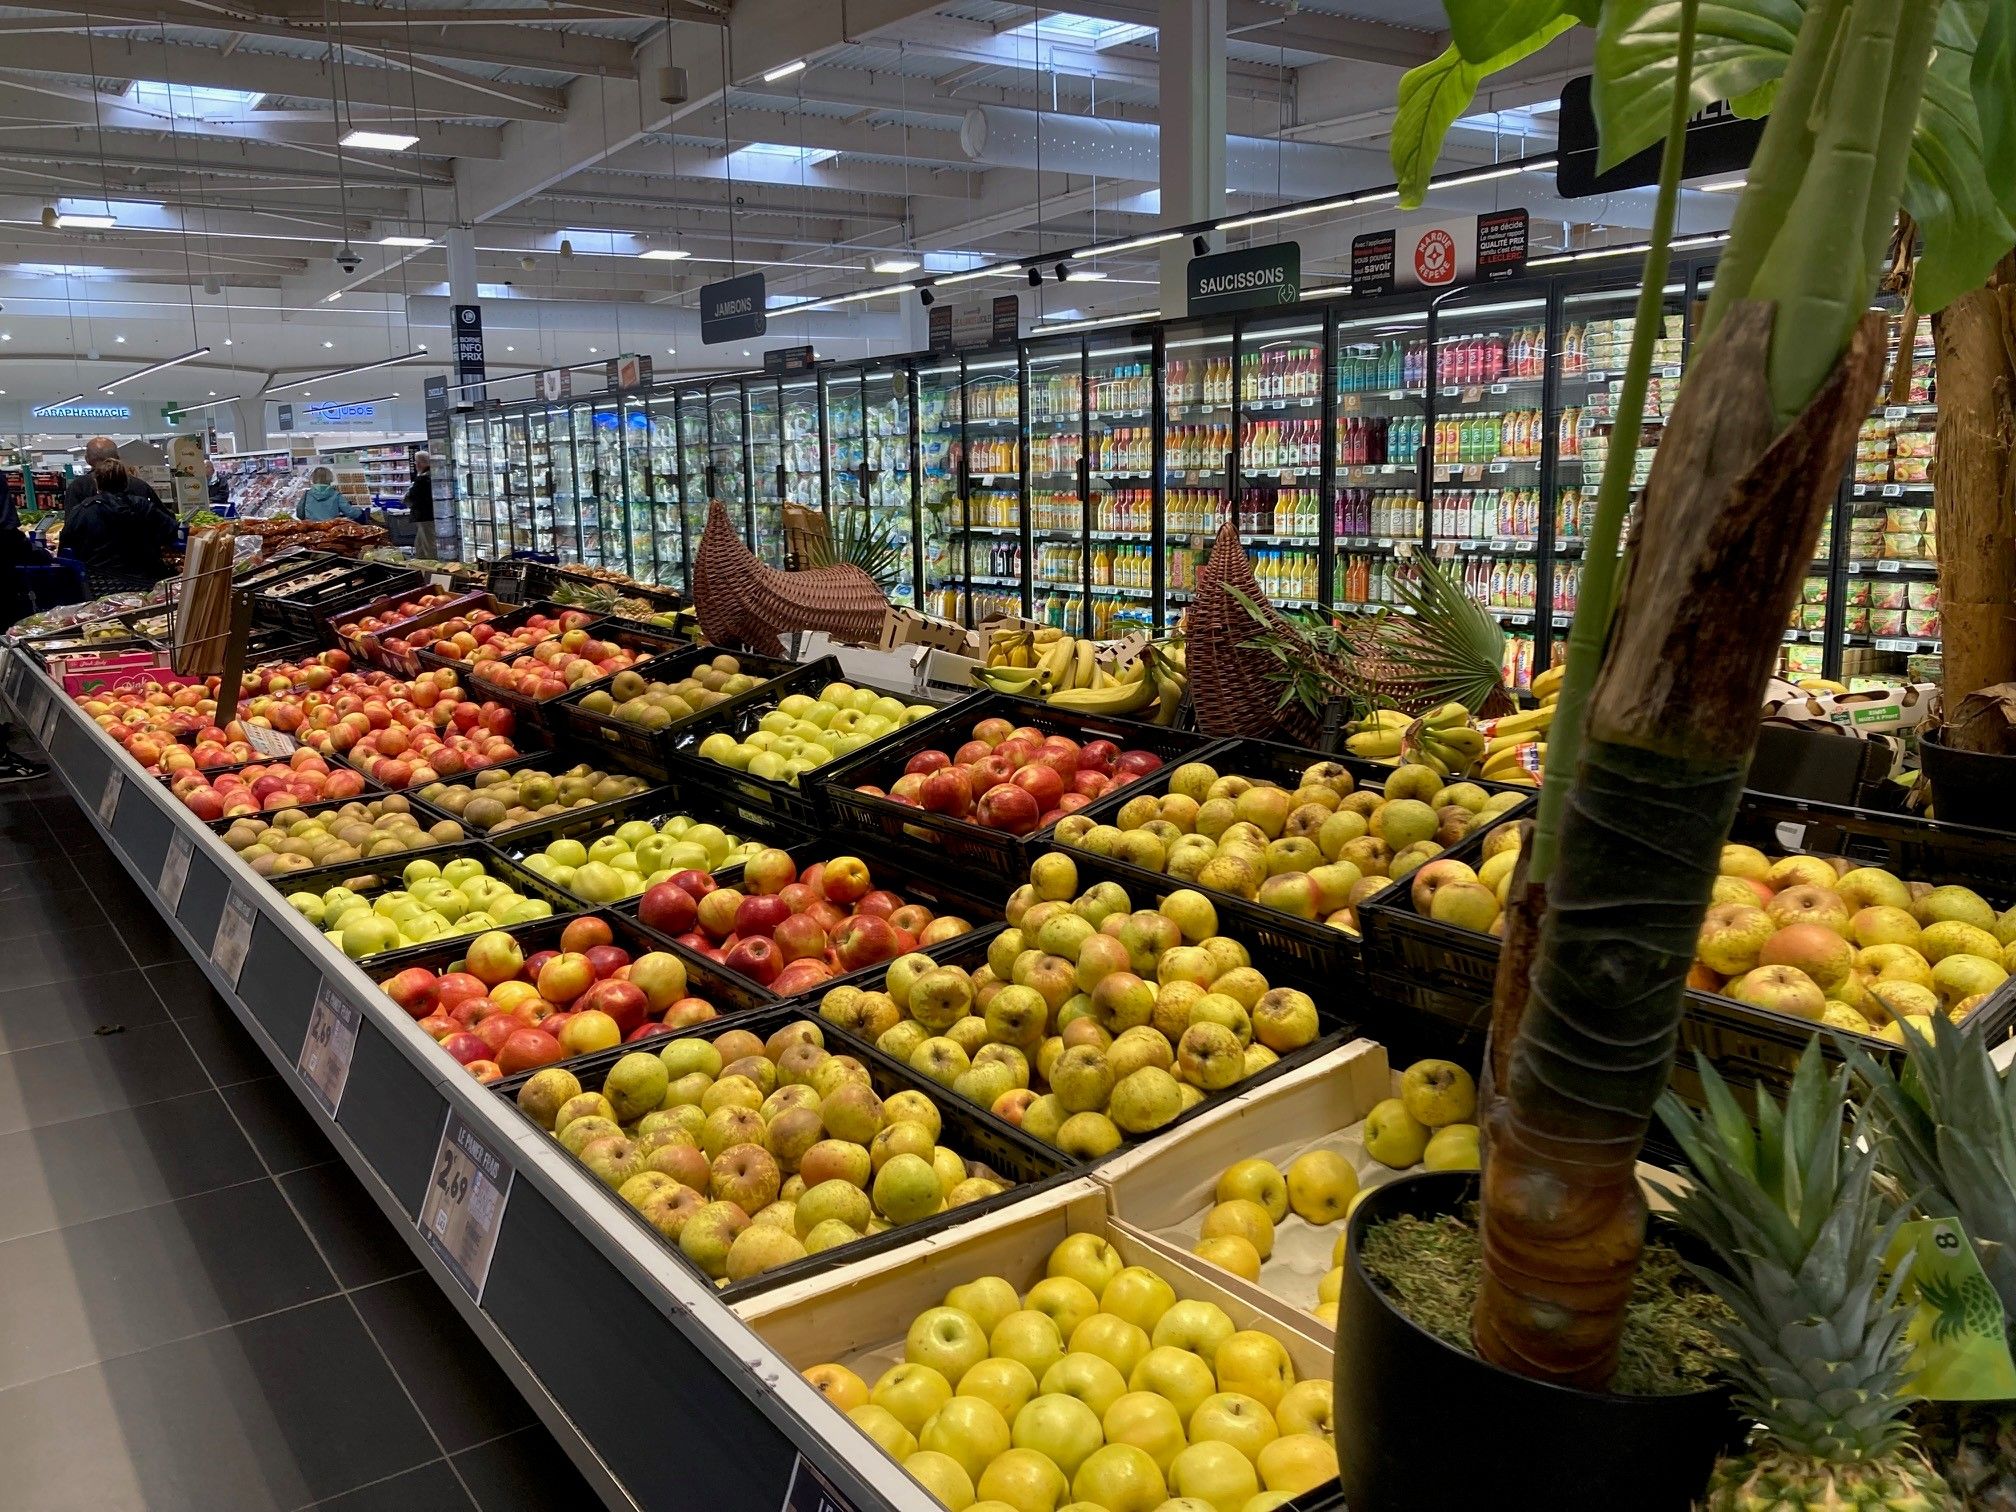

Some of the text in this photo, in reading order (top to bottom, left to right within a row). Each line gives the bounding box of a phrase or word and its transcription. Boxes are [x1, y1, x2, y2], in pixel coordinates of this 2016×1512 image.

[1418, 232, 1452, 252] MARQUE
[1509, 237, 1525, 245] PRIX
[1364, 261, 1391, 273] savoir
[1200, 267, 1284, 294] SAUCISSONS
[714, 297, 752, 317] JAMBONS
[460, 343, 482, 352] INFO
[460, 352, 482, 361] PRIX
[457, 1126, 500, 1179] LE PANIER FRAIS
